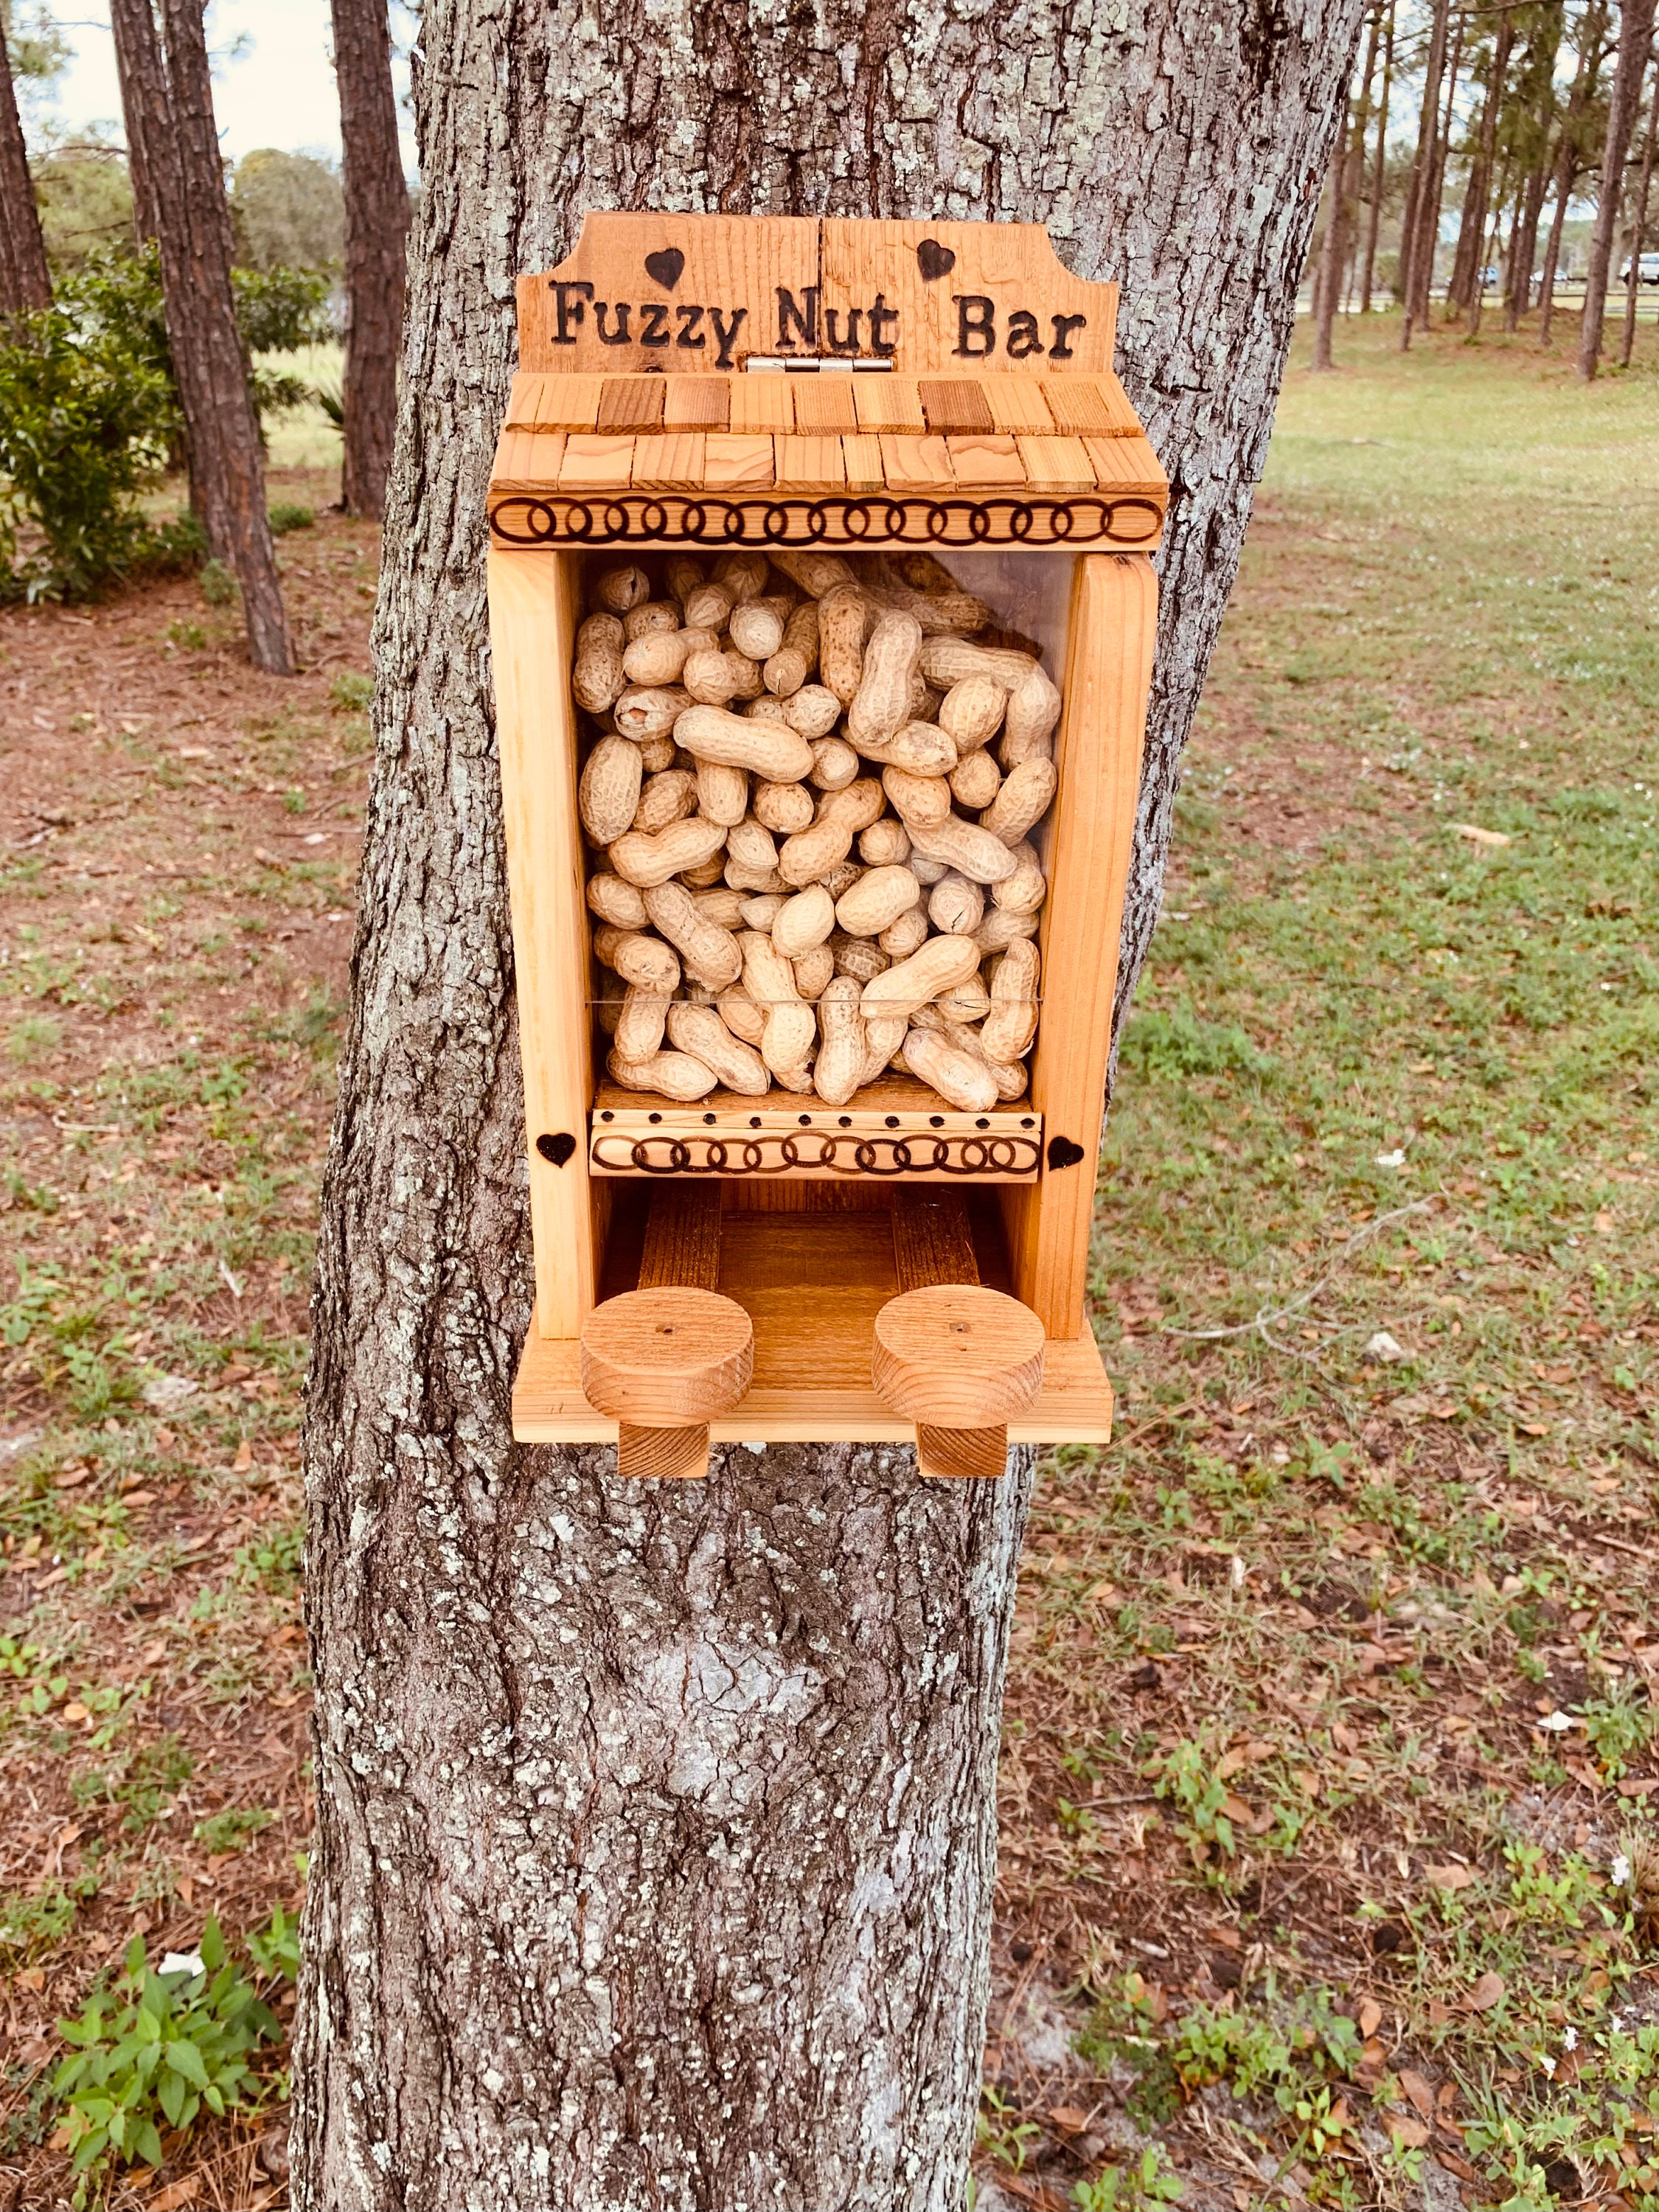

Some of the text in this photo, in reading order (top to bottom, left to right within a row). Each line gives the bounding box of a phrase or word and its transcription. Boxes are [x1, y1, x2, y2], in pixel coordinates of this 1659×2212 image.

[548, 281, 1087, 369] Fuzzy Nut Bar
